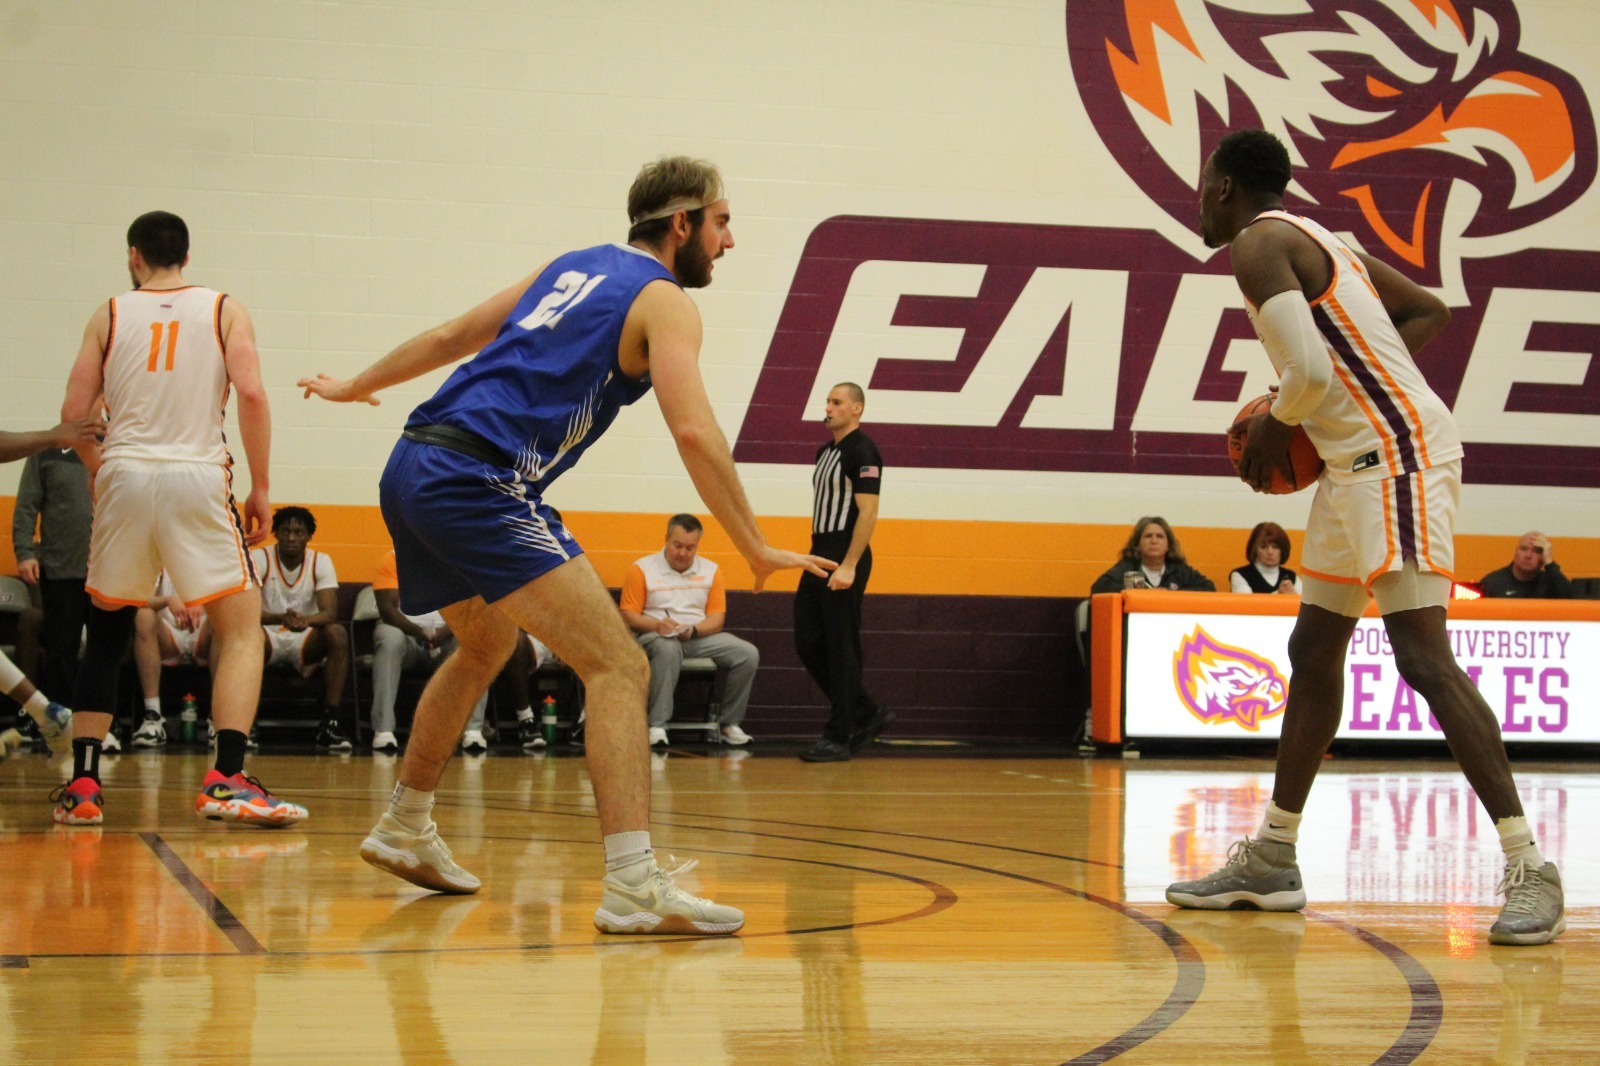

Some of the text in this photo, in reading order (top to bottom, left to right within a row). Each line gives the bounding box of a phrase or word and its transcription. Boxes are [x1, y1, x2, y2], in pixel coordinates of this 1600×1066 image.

[516, 270, 608, 330] 21
[147, 320, 180, 372] 11
[1350, 628, 1570, 659] POS IVERSITY
[1349, 664, 1569, 733] EAES
